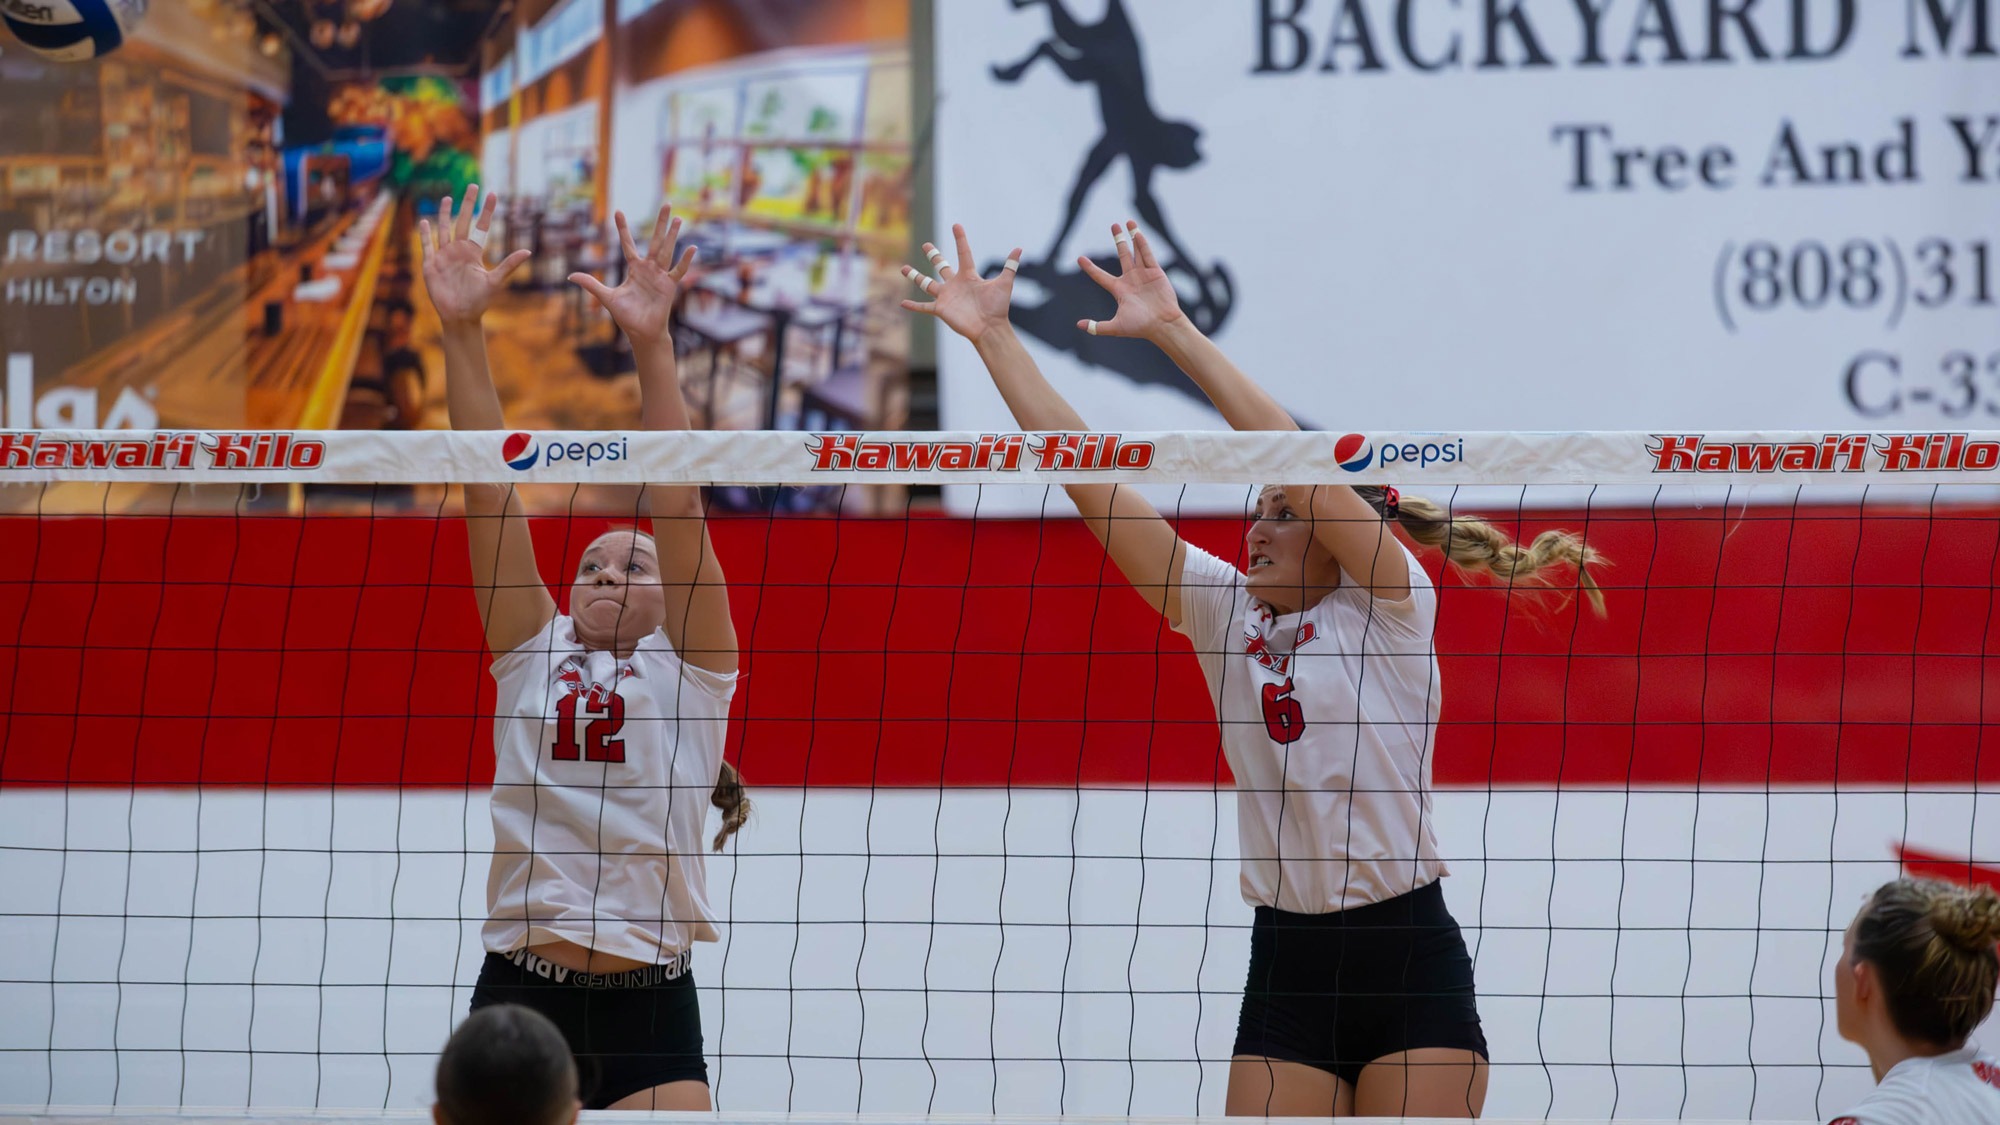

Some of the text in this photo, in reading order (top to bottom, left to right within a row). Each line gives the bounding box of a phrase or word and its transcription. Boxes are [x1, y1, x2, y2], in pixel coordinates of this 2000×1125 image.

[1248, 0, 1860, 76] BACKYARD
[1550, 114, 2000, 192] Tree And Y
[7, 229, 206, 265] RESORT
[6, 276, 138, 306] HILTON
[1713, 236, 1998, 335] (808)31
[201, 432, 326, 470] Hilo
[546, 437, 628, 467] pepsi
[1027, 433, 1156, 471] Hilo
[1380, 438, 1463, 468] pepsi
[1872, 433, 2000, 472] Hilo
[551, 692, 626, 763] 12
[1261, 676, 1306, 745] 6
